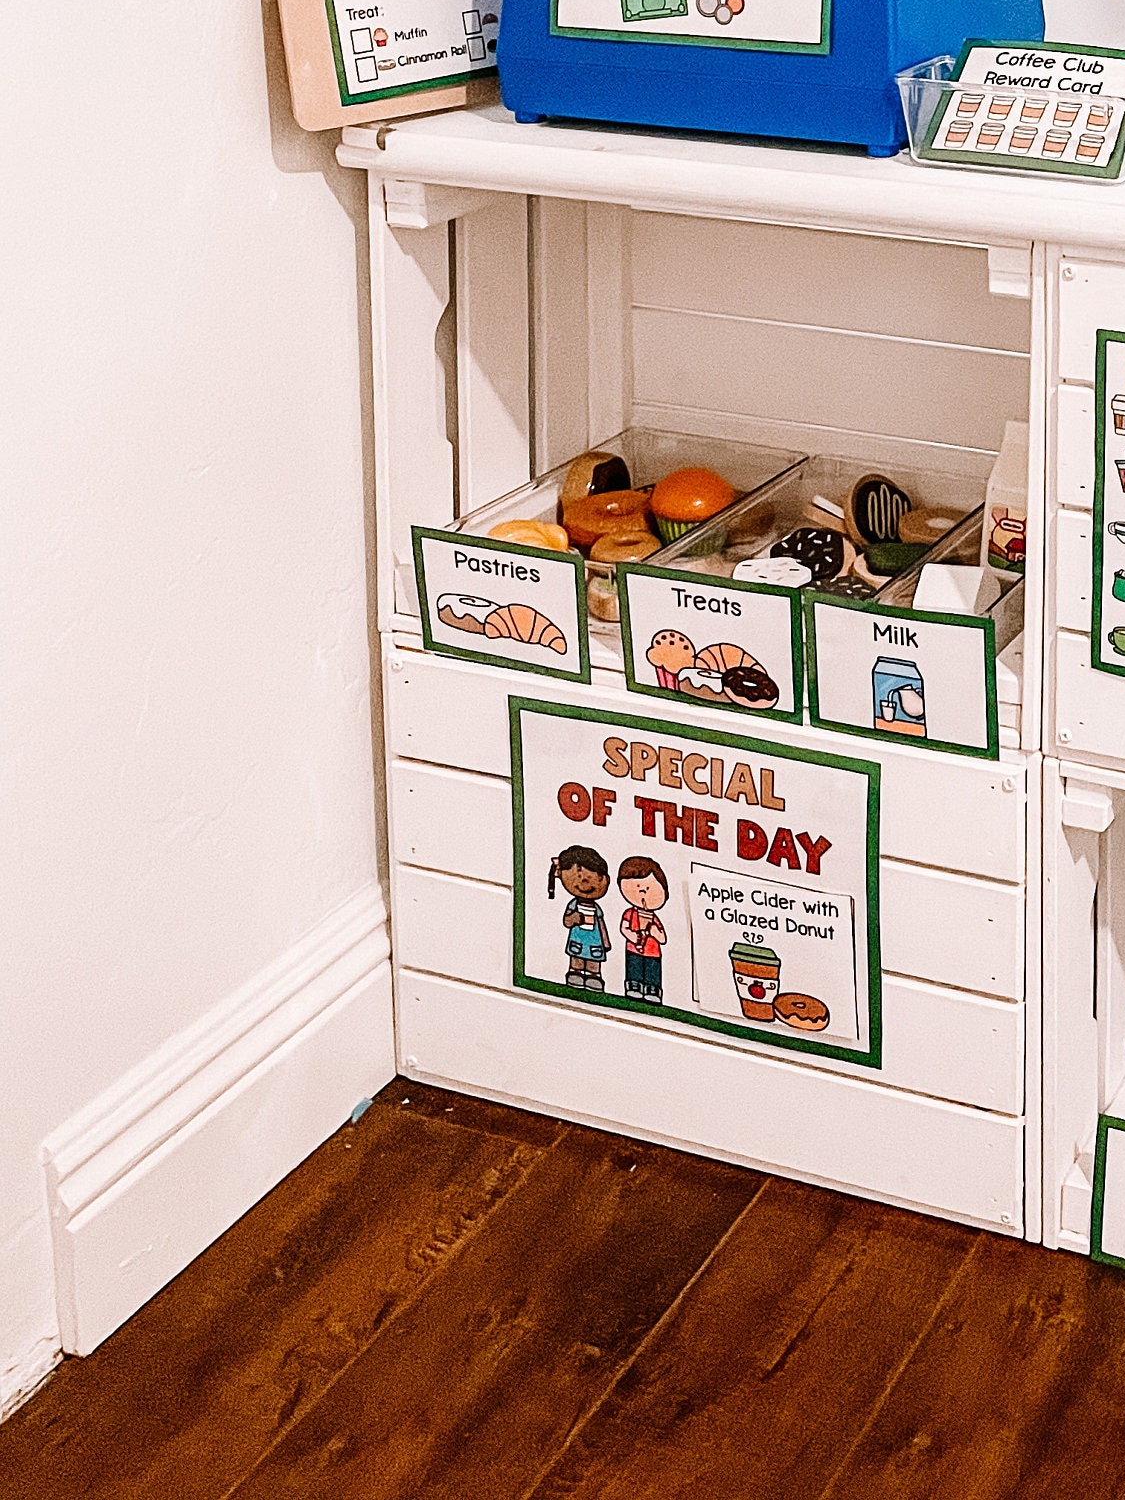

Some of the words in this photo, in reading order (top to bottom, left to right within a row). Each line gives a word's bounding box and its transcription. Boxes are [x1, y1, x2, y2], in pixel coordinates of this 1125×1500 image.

[346, 6, 384, 20] Treat:
[395, 28, 427, 41] Muffin
[398, 51, 447, 66] Cinnamon
[451, 44, 468, 56] Roll
[996, 51, 1057, 69] Coffee
[1063, 58, 1104, 74] Club
[984, 71, 1052, 90] Reward
[1058, 78, 1103, 95] Card
[453, 549, 541, 584] Pastries
[671, 587, 743, 617] Treats
[873, 622, 919, 649] Milk
[602, 737, 786, 812] SPECIAL
[557, 781, 617, 827] OF
[634, 795, 719, 852] THE
[736, 818, 832, 876] DAY
[698, 882, 744, 903] Apple
[751, 890, 796, 910] Cider
[803, 901, 838, 917] with
[705, 909, 714, 920] a
[720, 908, 779, 930] Glazed
[786, 918, 834, 940] Donut
